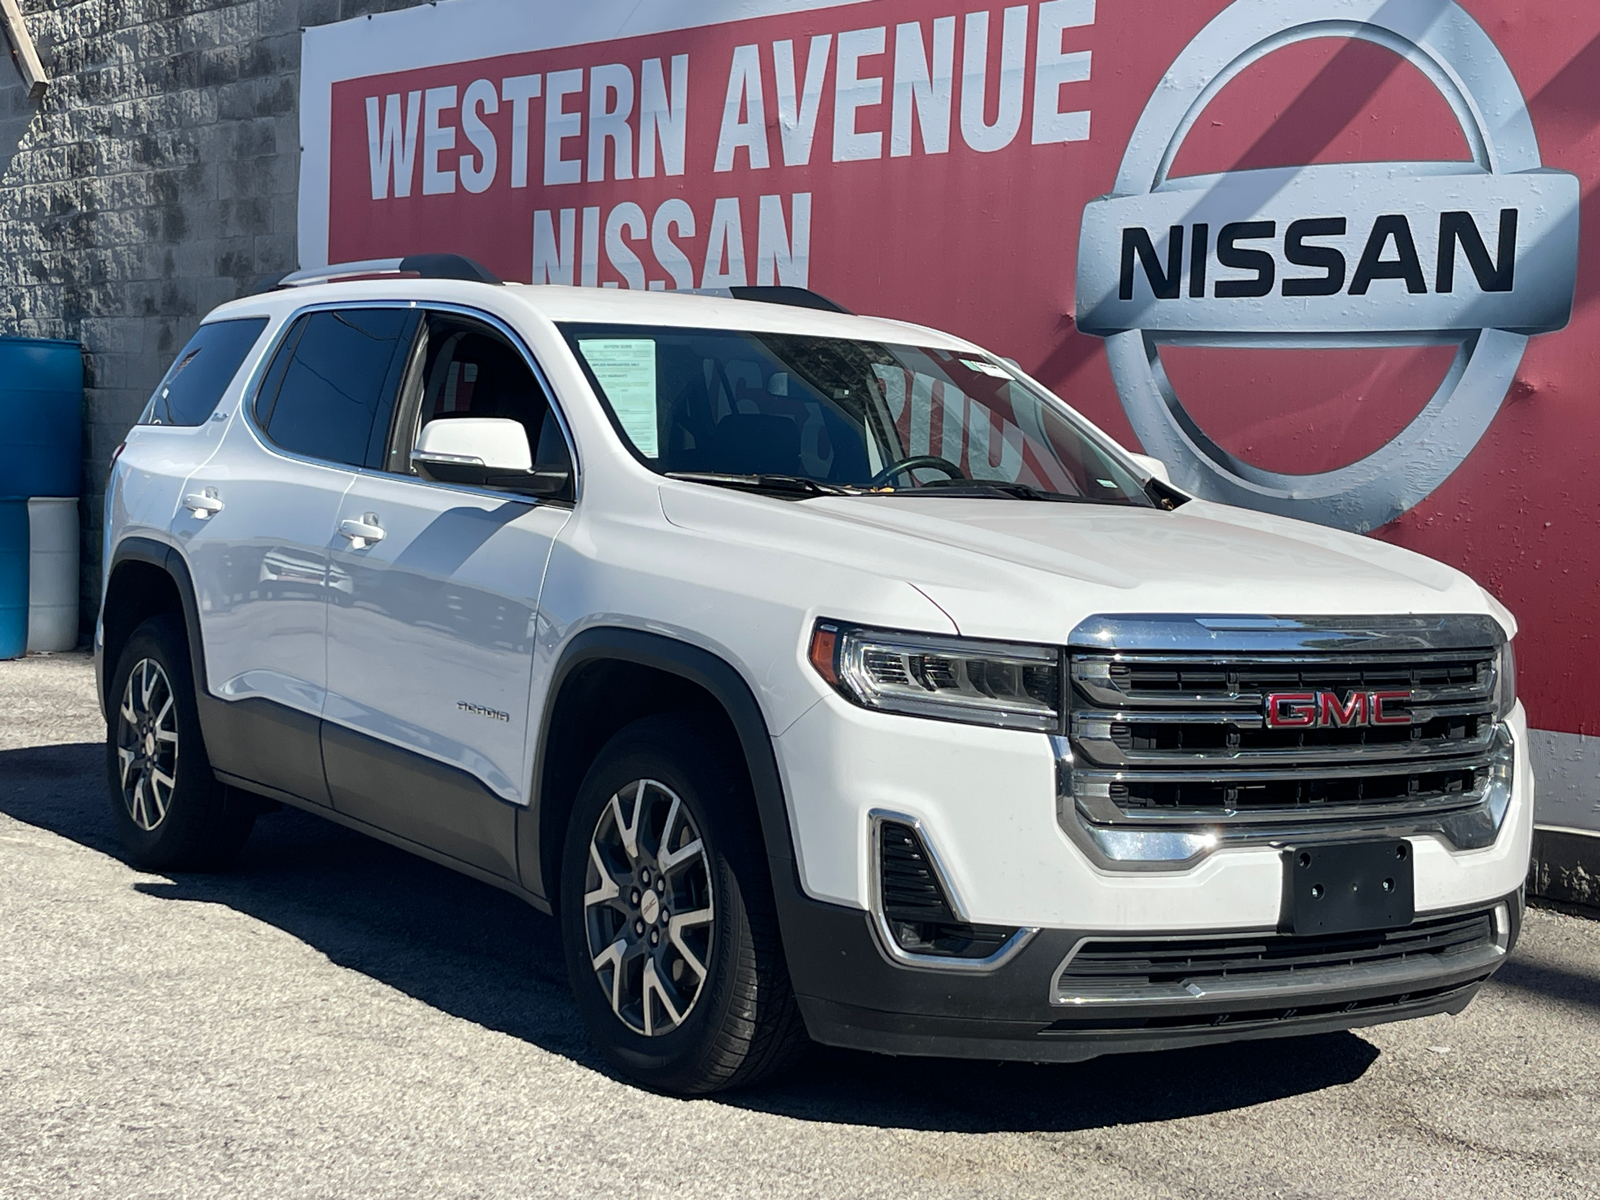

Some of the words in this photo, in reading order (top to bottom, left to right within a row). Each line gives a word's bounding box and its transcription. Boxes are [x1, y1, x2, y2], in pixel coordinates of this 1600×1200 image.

[365, 53, 690, 200] WESTERN
[713, 0, 1096, 172] AVENUE
[532, 192, 812, 290] NISSAN
[1118, 208, 1518, 300] NISSAN
[1265, 690, 1412, 728] GMC
